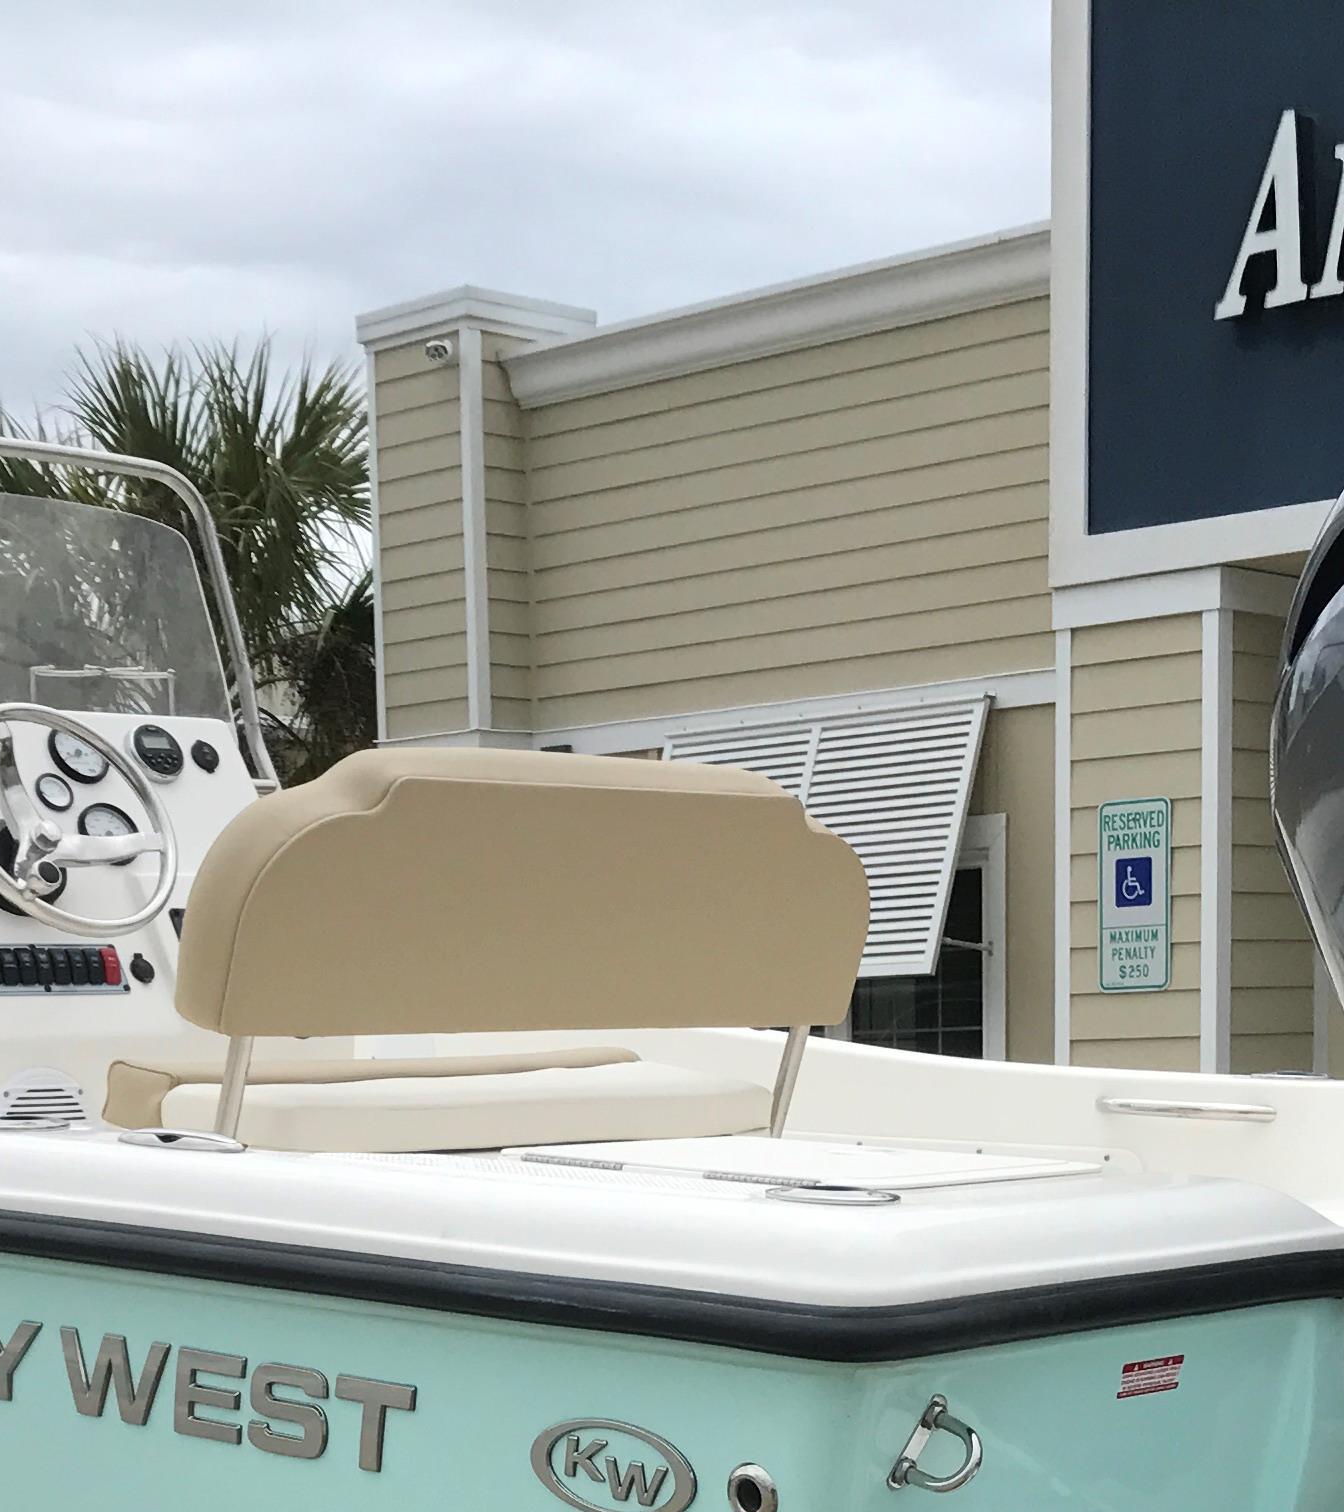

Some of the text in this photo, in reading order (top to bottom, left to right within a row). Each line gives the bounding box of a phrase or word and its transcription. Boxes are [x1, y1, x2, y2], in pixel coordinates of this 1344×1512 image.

[1103, 810, 1165, 833] RESERVED
[1107, 830, 1161, 851] PARKING
[1109, 929, 1159, 943] MAXIMUM
[1111, 946, 1156, 961] PENALTY
[1119, 965, 1150, 979] $250
[59, 1326, 417, 1473] WEST
[564, 1434, 669, 1507] KW
